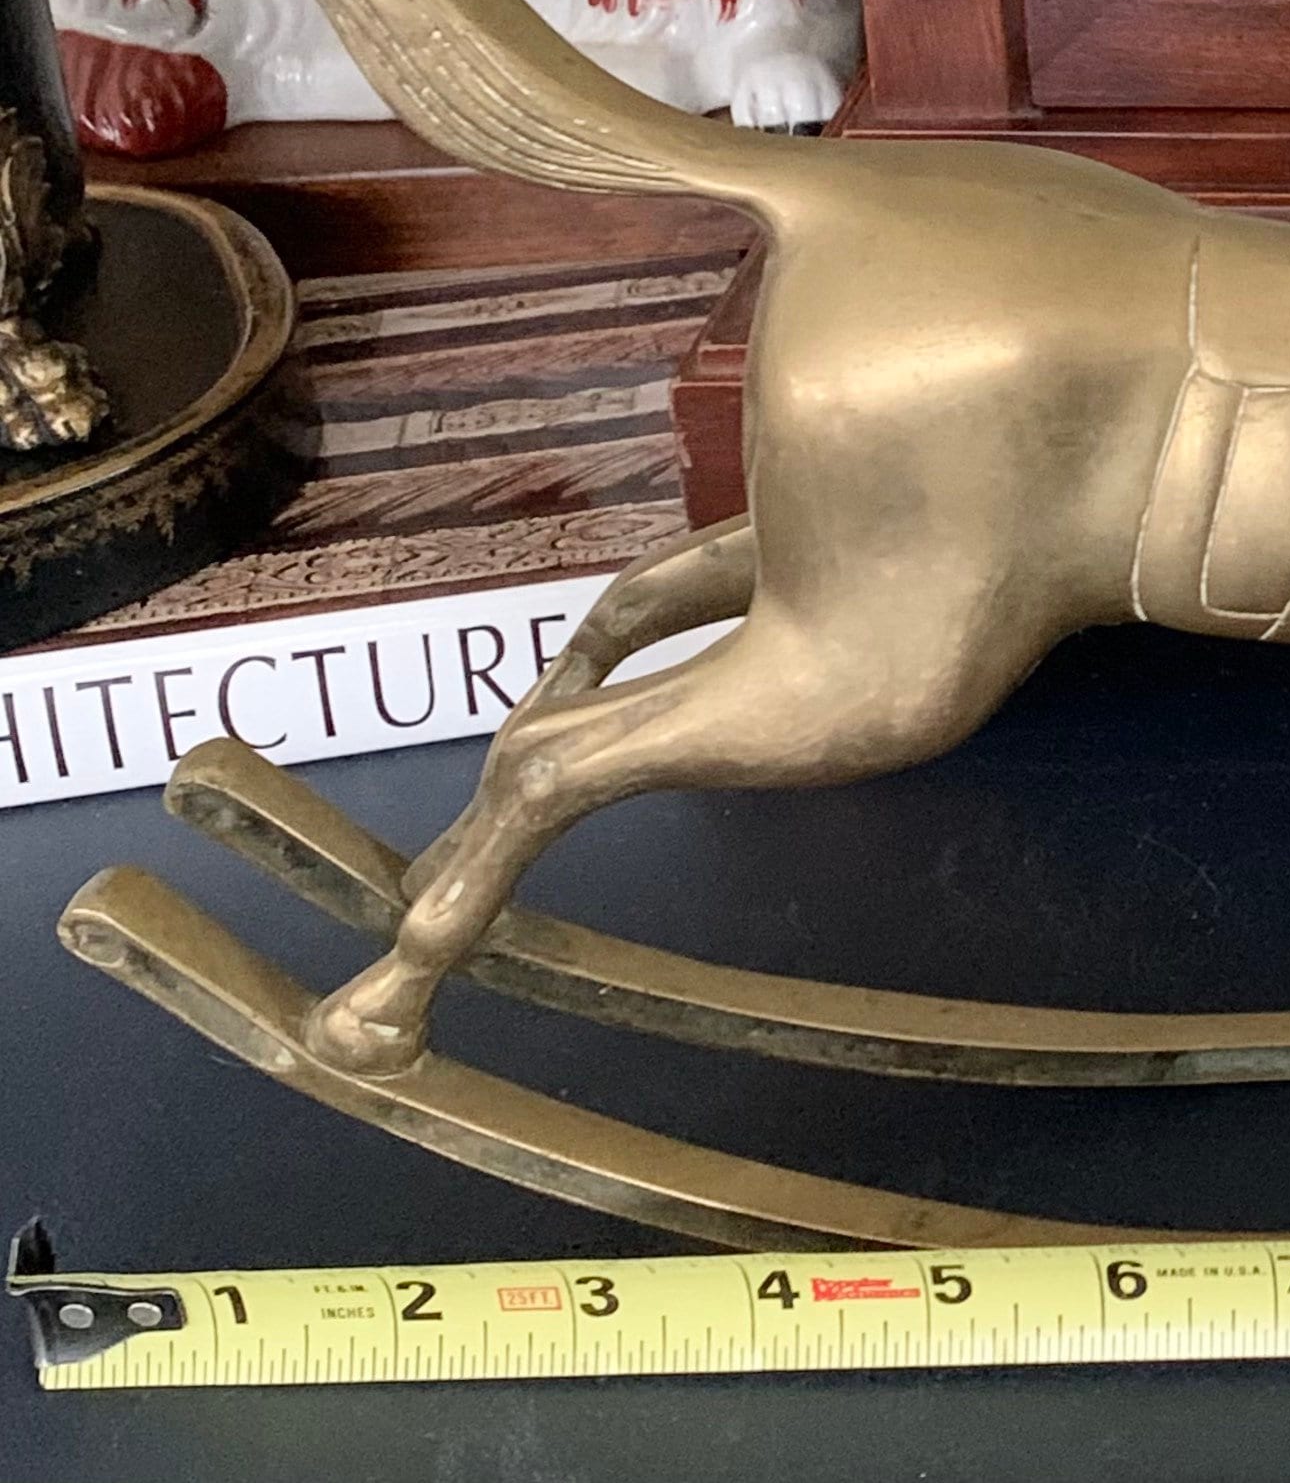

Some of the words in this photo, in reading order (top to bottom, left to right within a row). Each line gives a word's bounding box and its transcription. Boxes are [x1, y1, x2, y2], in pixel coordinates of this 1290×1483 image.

[574, 1276, 620, 1316] 3
[757, 1269, 799, 1309] 4
[930, 1264, 972, 1304] 5
[1106, 1260, 1147, 1300] 6
[213, 1285, 248, 1325] 1
[320, 1307, 375, 1319] INCHES
[395, 1280, 443, 1321] 2
